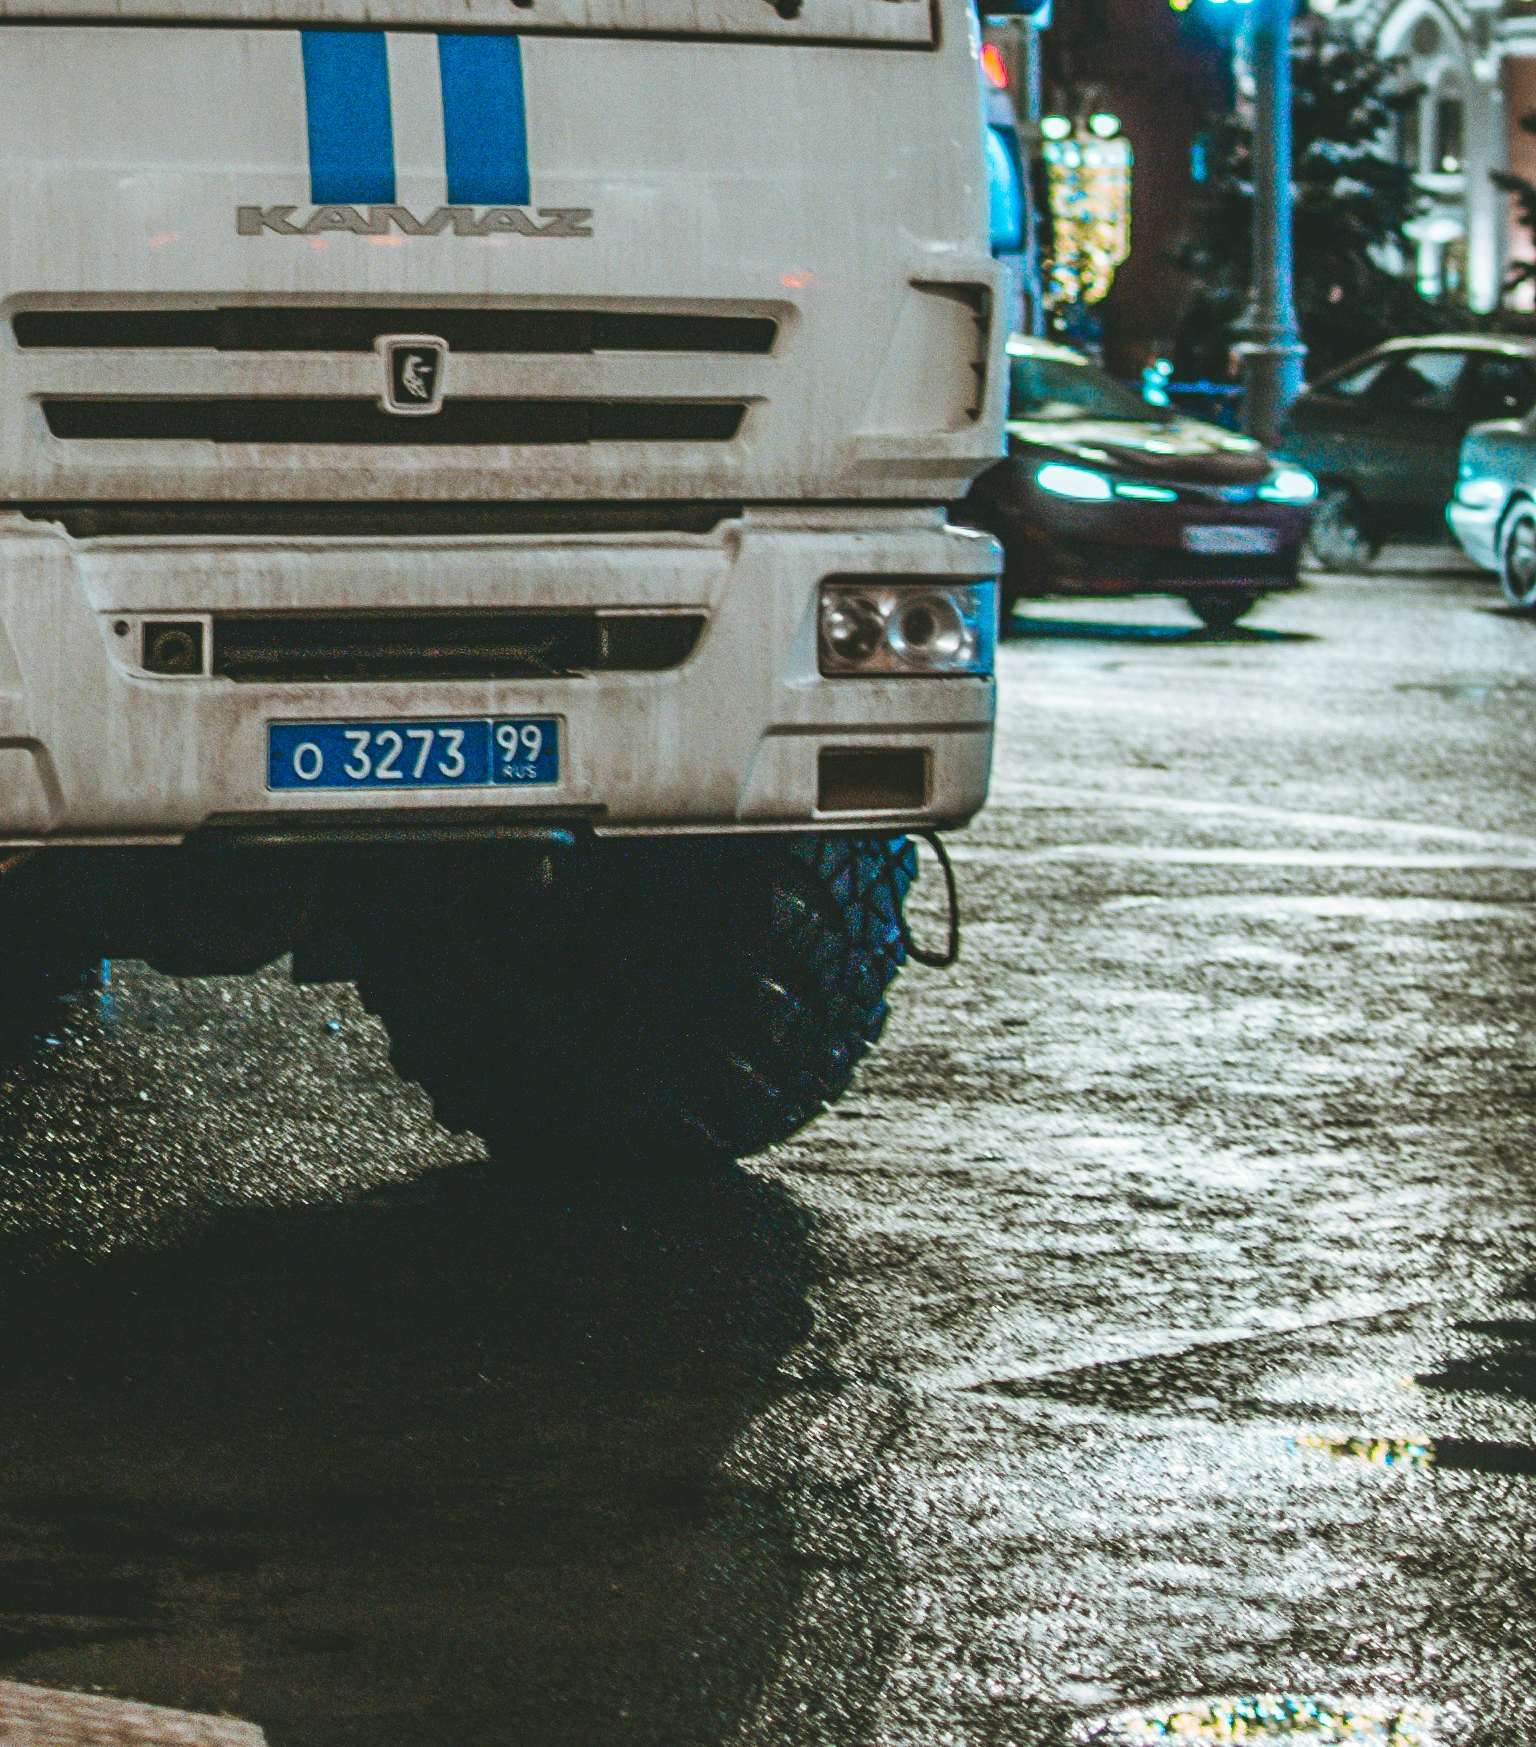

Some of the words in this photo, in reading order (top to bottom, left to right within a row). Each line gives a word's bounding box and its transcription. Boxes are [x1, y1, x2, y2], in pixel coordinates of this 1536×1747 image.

[235, 204, 594, 238] KAMAZ
[343, 728, 465, 780] 3273
[495, 724, 543, 763] 99
